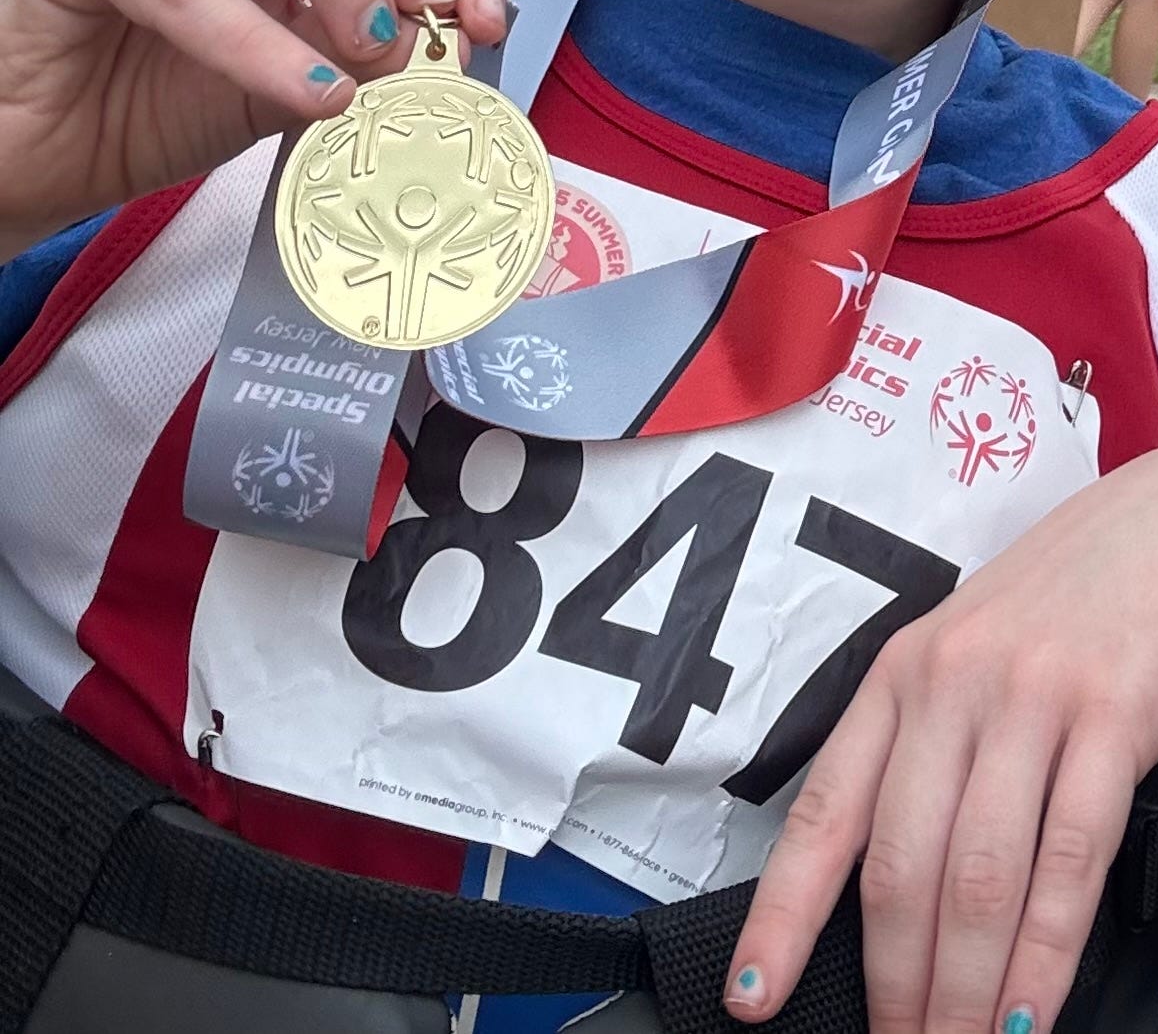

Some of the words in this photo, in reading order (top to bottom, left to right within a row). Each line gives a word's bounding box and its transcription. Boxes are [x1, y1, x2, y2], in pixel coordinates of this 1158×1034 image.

[888, 43, 938, 121] MER
[571, 198, 625, 276] SUMMER
[254, 315, 331, 348] Jersey
[229, 346, 396, 396] Olympics
[233, 380, 371, 424] Special
[809, 386, 896, 438] Jersey
[342, 399, 962, 807] 847
[358, 777, 398, 794] printed
[398, 786, 412, 800] by
